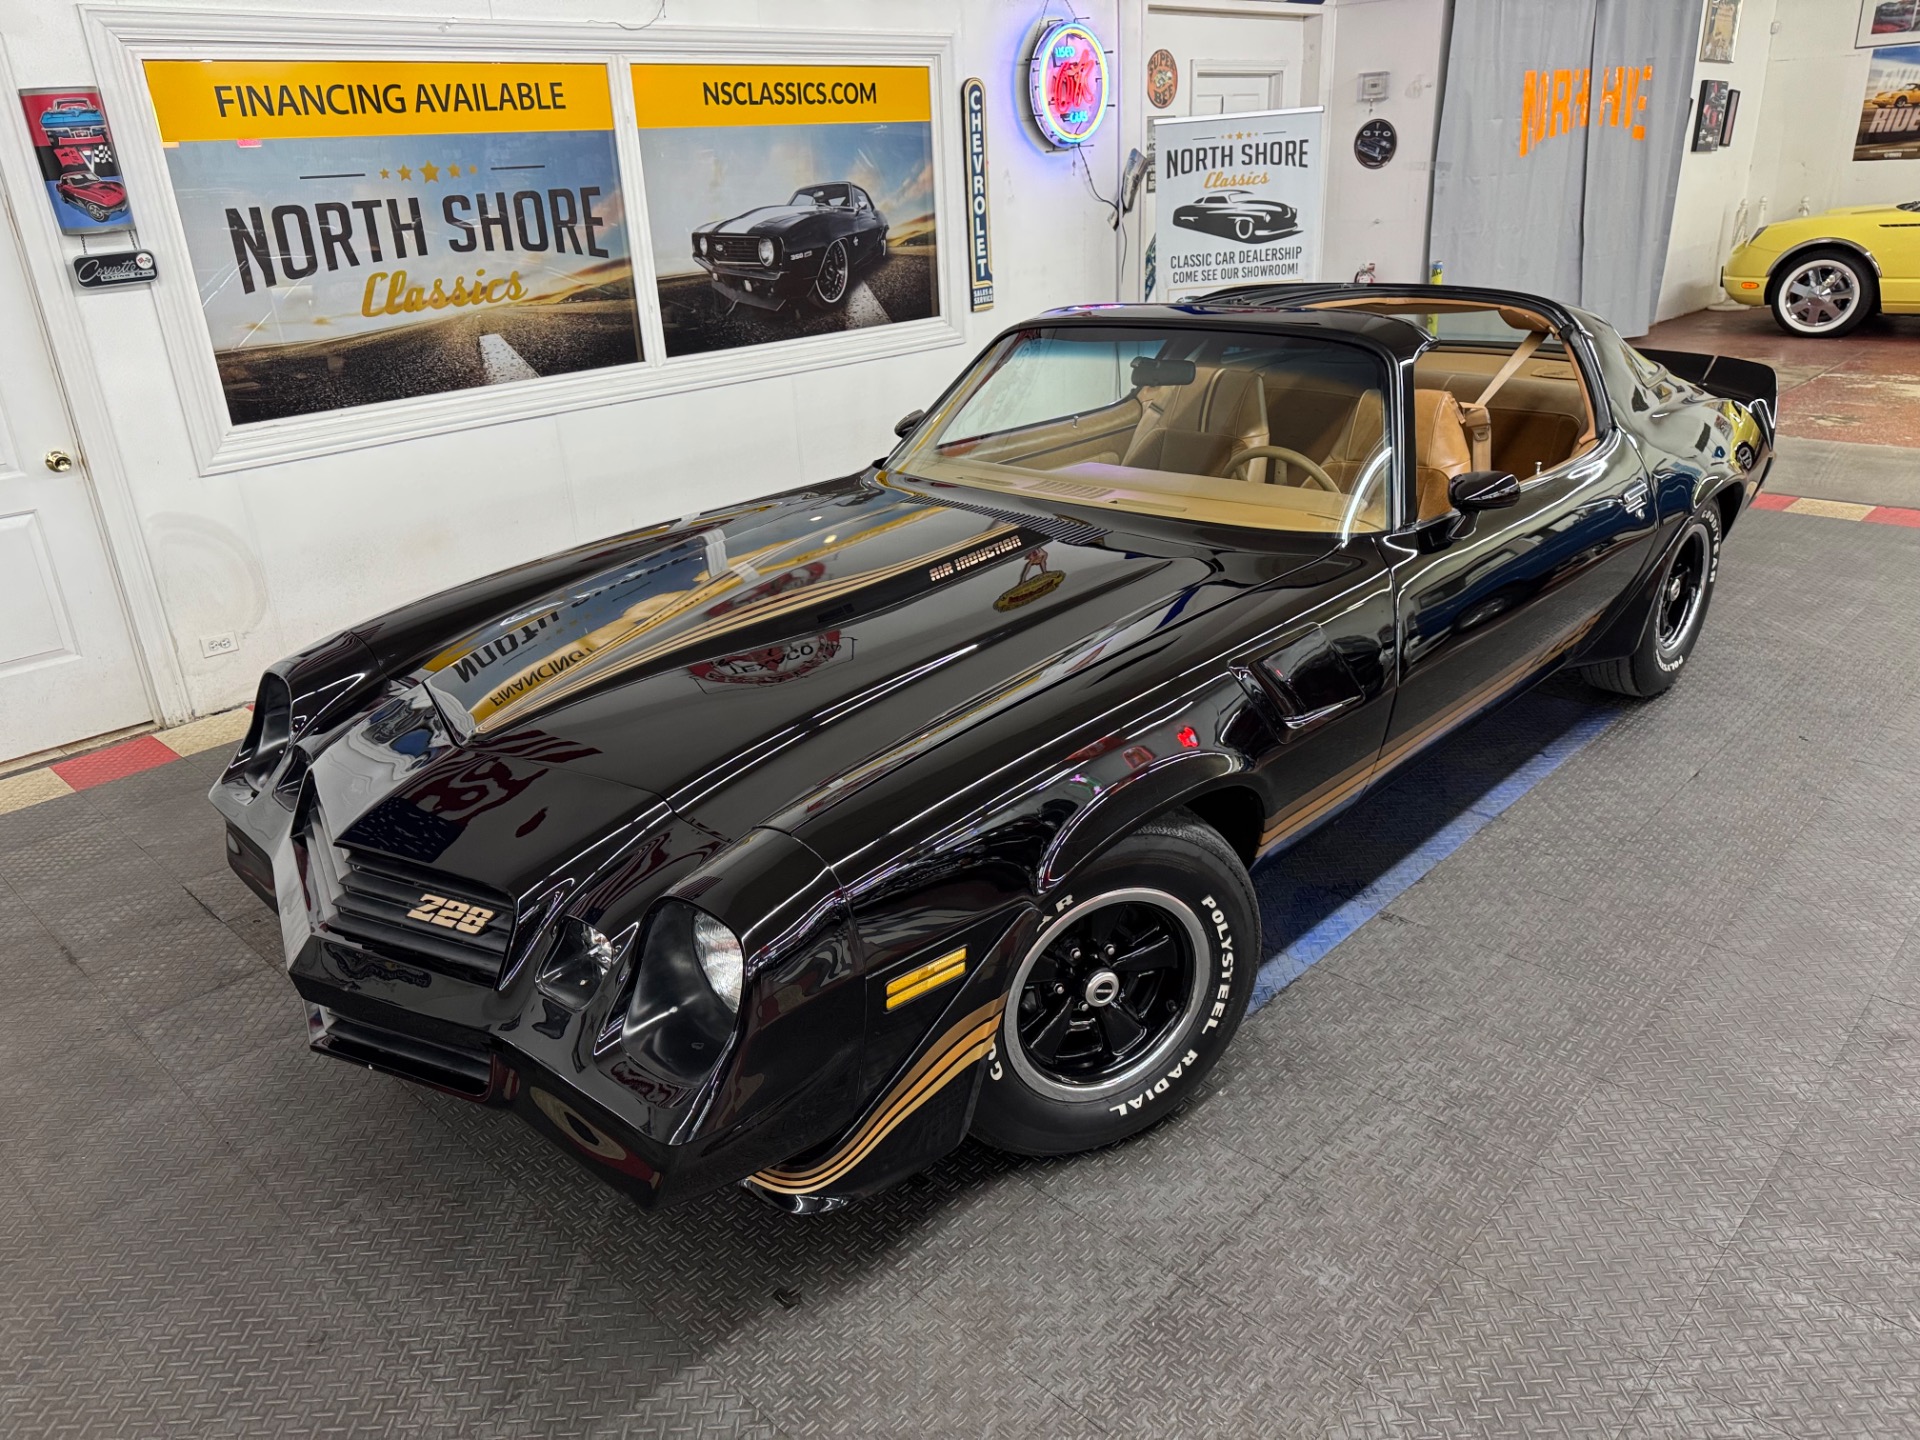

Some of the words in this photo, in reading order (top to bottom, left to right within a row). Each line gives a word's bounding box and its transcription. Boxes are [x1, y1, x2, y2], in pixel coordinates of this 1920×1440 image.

[214, 84, 406, 117] FINANCING
[414, 81, 567, 113] AVAILABLE
[702, 81, 878, 107] NSCLASSICS.COM
[1166, 145, 1234, 179] NORTH
[1241, 139, 1309, 168] SHORE
[970, 90, 987, 277] CHEVROLET
[1203, 171, 1270, 189] Classics
[225, 197, 428, 295] NORTH
[442, 186, 610, 259] SHORE
[1170, 253, 1212, 269] CLASSIC
[1215, 251, 1236, 265] CAR
[1238, 246, 1302, 264] DEALERSHIP
[78, 260, 138, 282] Corvette
[1172, 270, 1199, 284] COME
[1201, 268, 1218, 281] SEE
[1220, 267, 1239, 280] OUR
[1241, 263, 1299, 278] SHOWROOM!
[361, 268, 529, 318] Classics
[928, 562, 954, 582] AIR
[953, 534, 1022, 571] INDUCTION
[406, 893, 495, 934] Z28
[1200, 894, 1234, 1035] POLYSTEEL
[1109, 1049, 1199, 1117] RADIAL
